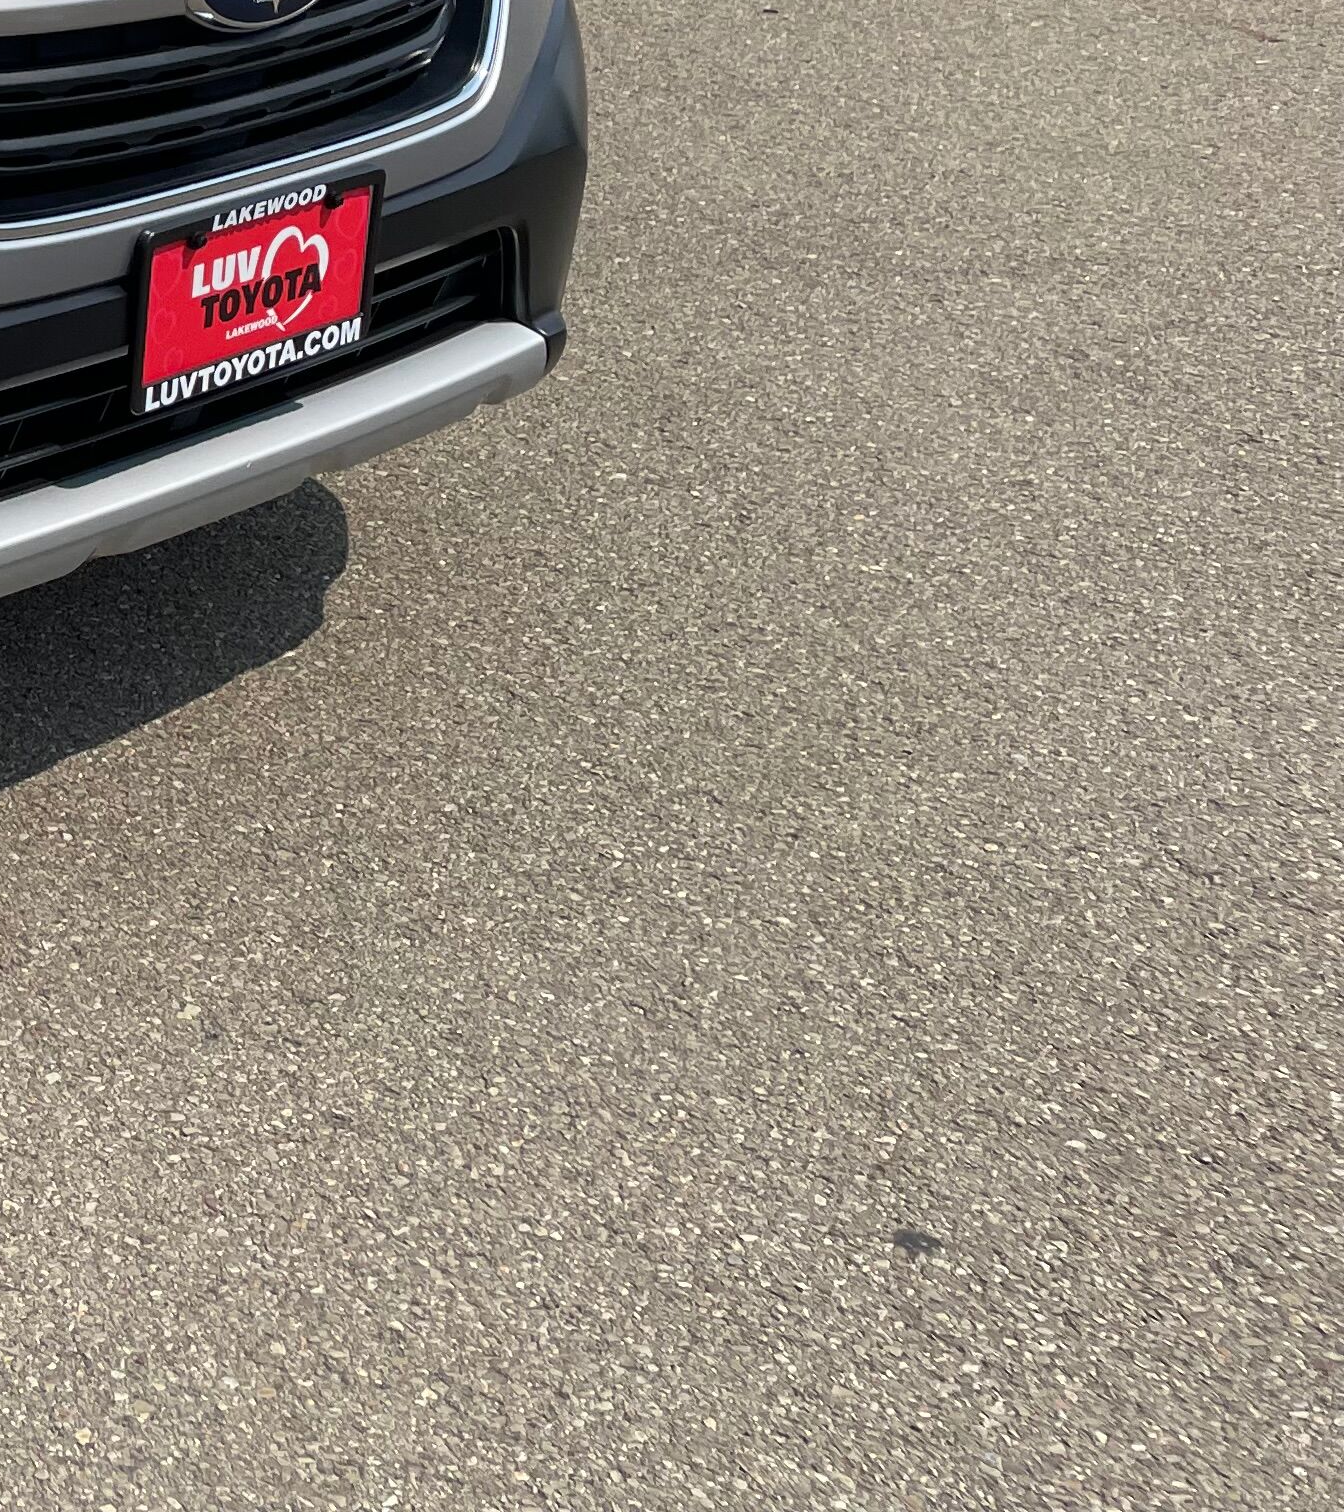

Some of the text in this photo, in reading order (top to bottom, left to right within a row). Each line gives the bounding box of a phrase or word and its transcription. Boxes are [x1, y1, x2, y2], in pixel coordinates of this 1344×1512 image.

[212, 184, 327, 232] LAKEWOOD
[191, 245, 262, 299] LUV
[201, 263, 322, 329] TOYOTA
[225, 315, 278, 340] LAKEWOOD
[144, 317, 362, 413] LUVTOYOTA.COM
